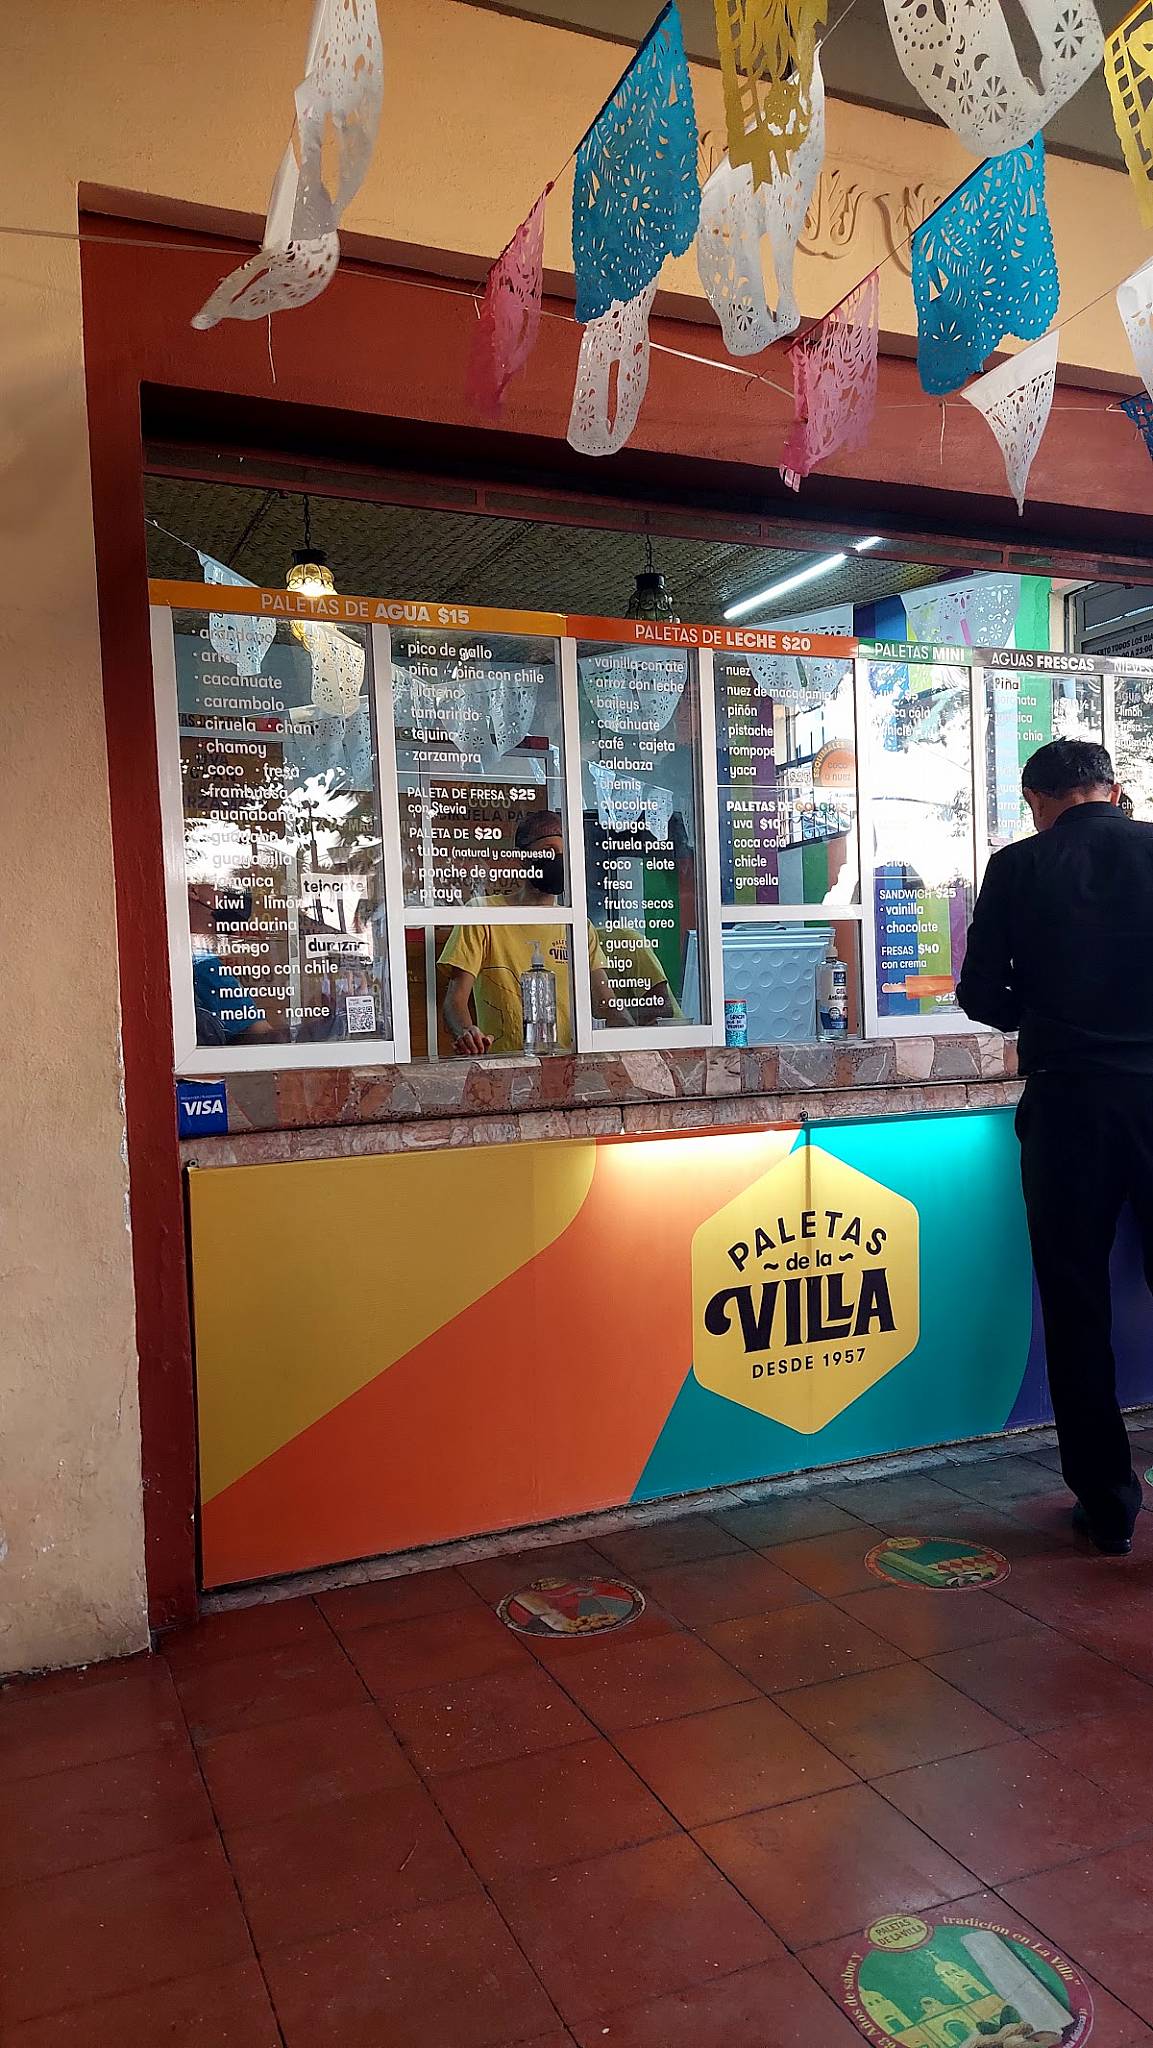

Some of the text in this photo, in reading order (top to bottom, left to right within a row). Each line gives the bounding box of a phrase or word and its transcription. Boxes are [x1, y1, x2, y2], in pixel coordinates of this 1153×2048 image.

[261, 594, 470, 625] PALETAS DE AGUA $15
[635, 624, 811, 651] PALETAS DE LECHE $20
[407, 641, 493, 661] pico de gallo
[874, 643, 965, 661] PALETAS MINI
[594, 655, 684, 673] vainilla con ate
[991, 652, 1095, 672] AGUAS FRESCAS
[408, 663, 544, 683] piña piña con chile
[726, 665, 751, 677] nuez
[202, 674, 283, 690] cacahuate
[595, 678, 684, 692] arroz con leche
[994, 677, 1019, 691] Piña
[726, 686, 752, 697] nuez
[753, 685, 767, 698] de
[204, 697, 286, 712] carambolo
[596, 695, 640, 714] baileys
[727, 703, 758, 718] piñón
[411, 705, 480, 721] tamarindo
[205, 717, 257, 733] ciruela
[275, 719, 314, 735] chan
[597, 716, 660, 732] cacahuate
[728, 723, 774, 738] pistache
[411, 727, 458, 744] tejuino
[206, 740, 268, 759] chamoy
[598, 736, 676, 754] café cajeta
[729, 746, 776, 759] rompope
[208, 765, 244, 777] coco
[263, 762, 300, 779] fresa
[598, 756, 654, 771] calabaza
[730, 766, 757, 779] yaca
[407, 787, 449, 799] PALETA
[451, 787, 467, 800] DE
[470, 788, 505, 800] FRESA
[509, 787, 536, 801] $25
[407, 801, 467, 817] con Stevia
[600, 798, 659, 811] chocolate
[726, 800, 775, 812] PALETAS
[777, 801, 793, 812] DE
[601, 818, 652, 834] chongos
[733, 817, 782, 831] uva $10
[409, 827, 502, 841] PALETA DE $20
[733, 836, 787, 848] coca cola
[601, 836, 674, 853] ciruela pasa
[417, 845, 555, 861] tuba (natural y compuesto)
[734, 854, 767, 867] chicle
[602, 857, 675, 870] coco elote
[418, 864, 544, 882] ponche de granada
[603, 876, 633, 890] fresa
[735, 873, 779, 890] grosella
[420, 885, 463, 902] pitaya
[879, 887, 957, 900] SANDWICH $25
[215, 896, 245, 910] kiwi
[604, 896, 674, 910] frutos secos
[885, 902, 924, 915] vainilla
[216, 918, 298, 933] mandarina
[604, 917, 675, 933] galleta oreo
[886, 920, 938, 933] chocolate
[217, 940, 270, 957] mango
[605, 938, 659, 952] guayaba
[881, 943, 940, 957] FRESAS $40
[549, 949, 569, 961] VILL
[218, 959, 338, 979] mango con chile
[607, 955, 633, 972] higo
[881, 959, 927, 970] con crema
[607, 977, 651, 991] mamey
[219, 985, 295, 1000] maracuya
[608, 994, 665, 1011] aguacate
[220, 1004, 330, 1020] melón nance
[181, 1099, 224, 1116] VISA
[727, 1211, 887, 1272] PALETAS
[786, 1250, 832, 1271] de la
[704, 1267, 898, 1353] VILLA
[752, 1348, 866, 1379] DESDE 1957
[943, 1915, 1010, 1936] tradición
[1012, 1932, 1031, 1945] en
[1031, 1942, 1051, 1957] La
[844, 1992, 858, 2007] de
